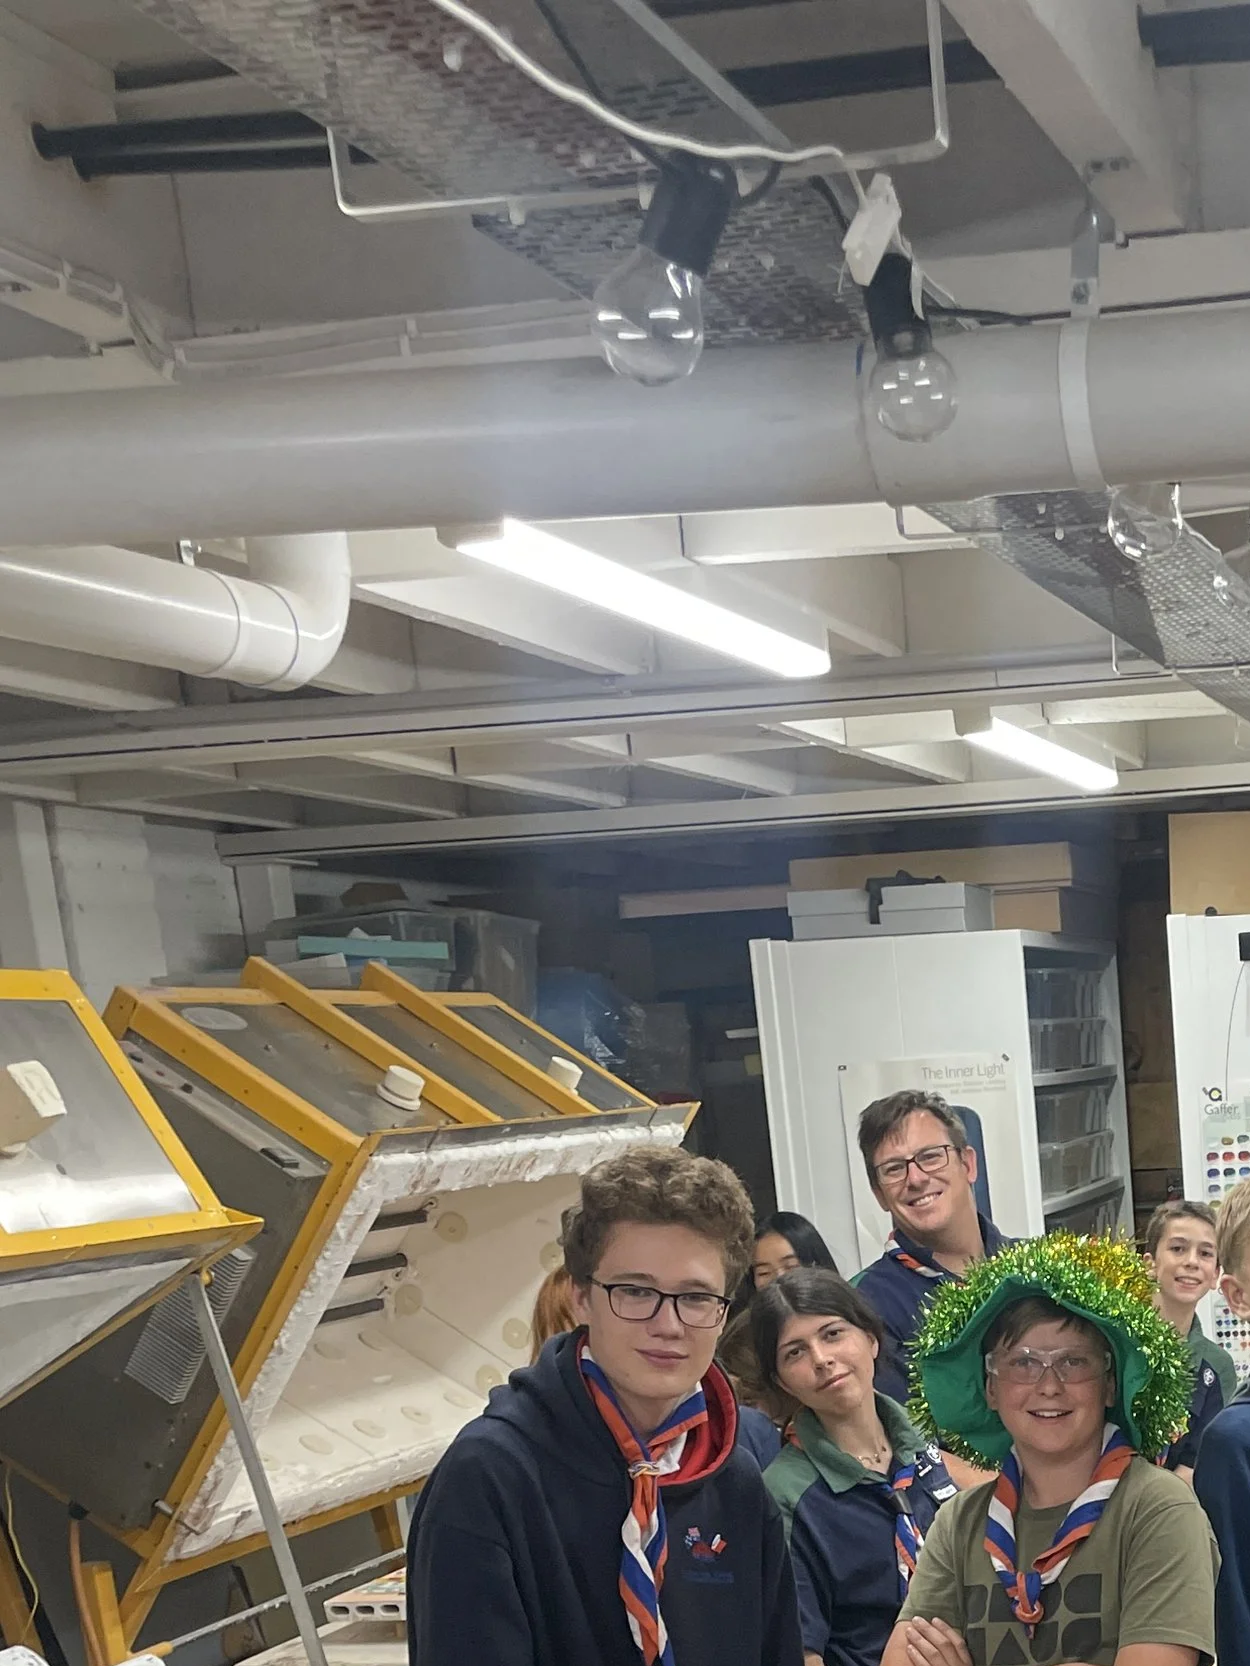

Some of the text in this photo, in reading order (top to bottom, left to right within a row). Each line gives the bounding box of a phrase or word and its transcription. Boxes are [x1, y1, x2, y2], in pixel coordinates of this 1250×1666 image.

[920, 1062, 1005, 1080] The Inner Light
[1204, 1103, 1239, 1116] Gaffer
